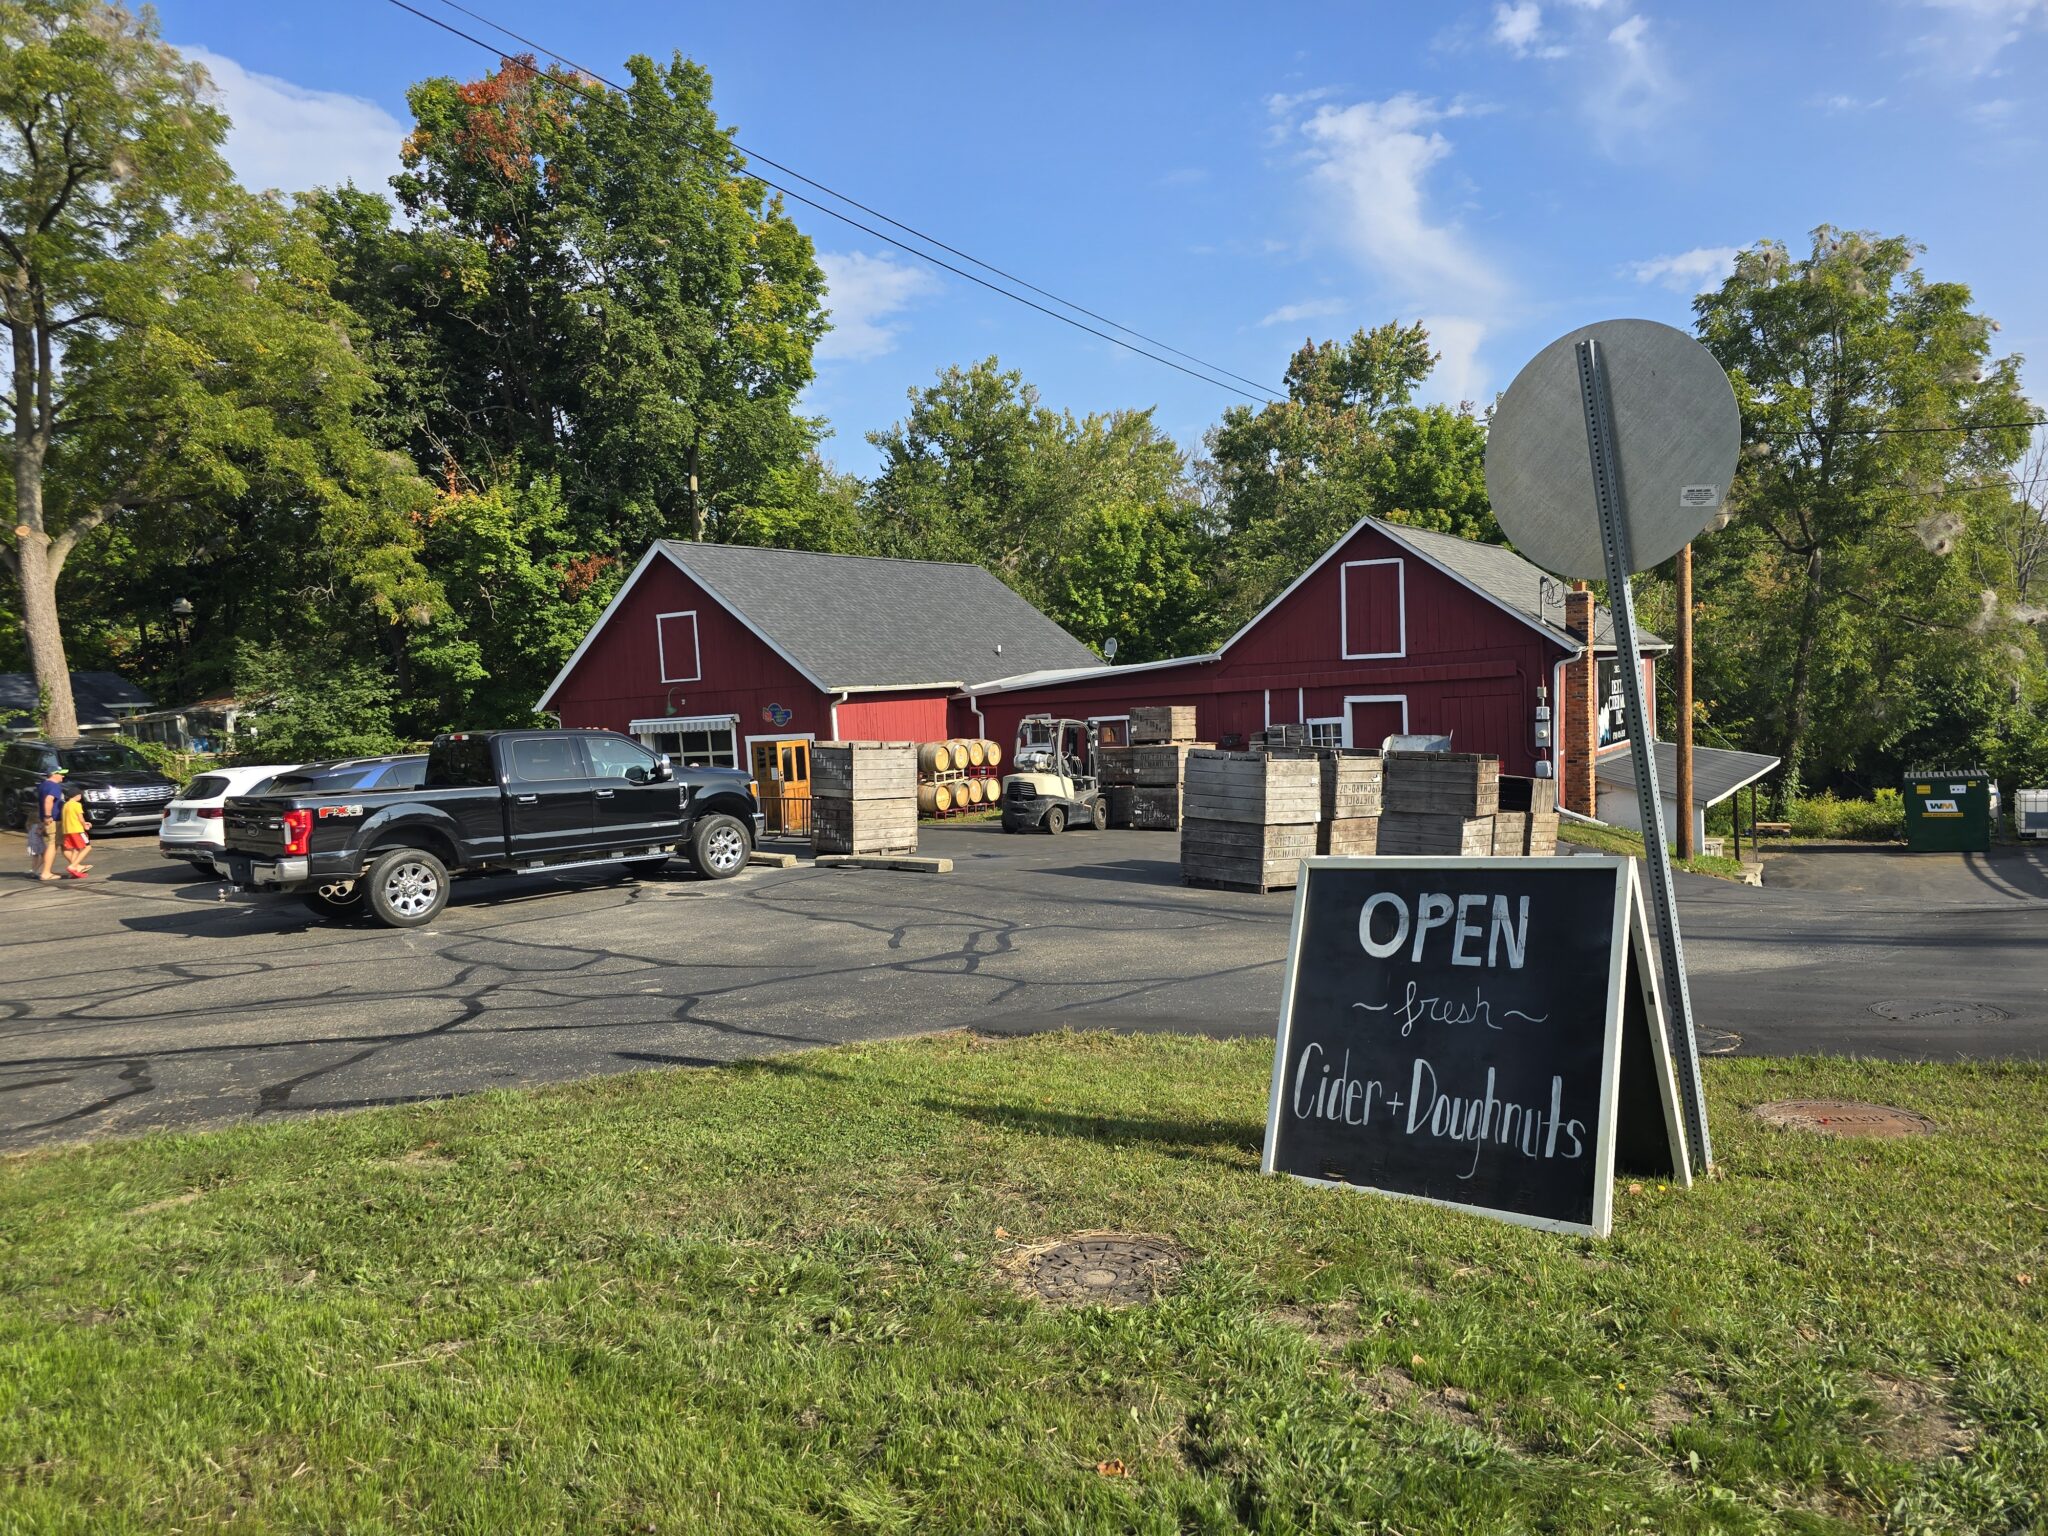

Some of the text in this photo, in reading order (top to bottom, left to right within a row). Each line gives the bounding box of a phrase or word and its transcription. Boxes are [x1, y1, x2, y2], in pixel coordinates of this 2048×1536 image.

[1358, 892, 1530, 968] OPEN
[1393, 981, 1503, 1037] fresh
[1293, 1042, 1383, 1126] Cider
[1405, 1058, 1587, 1180] Doughnuts
